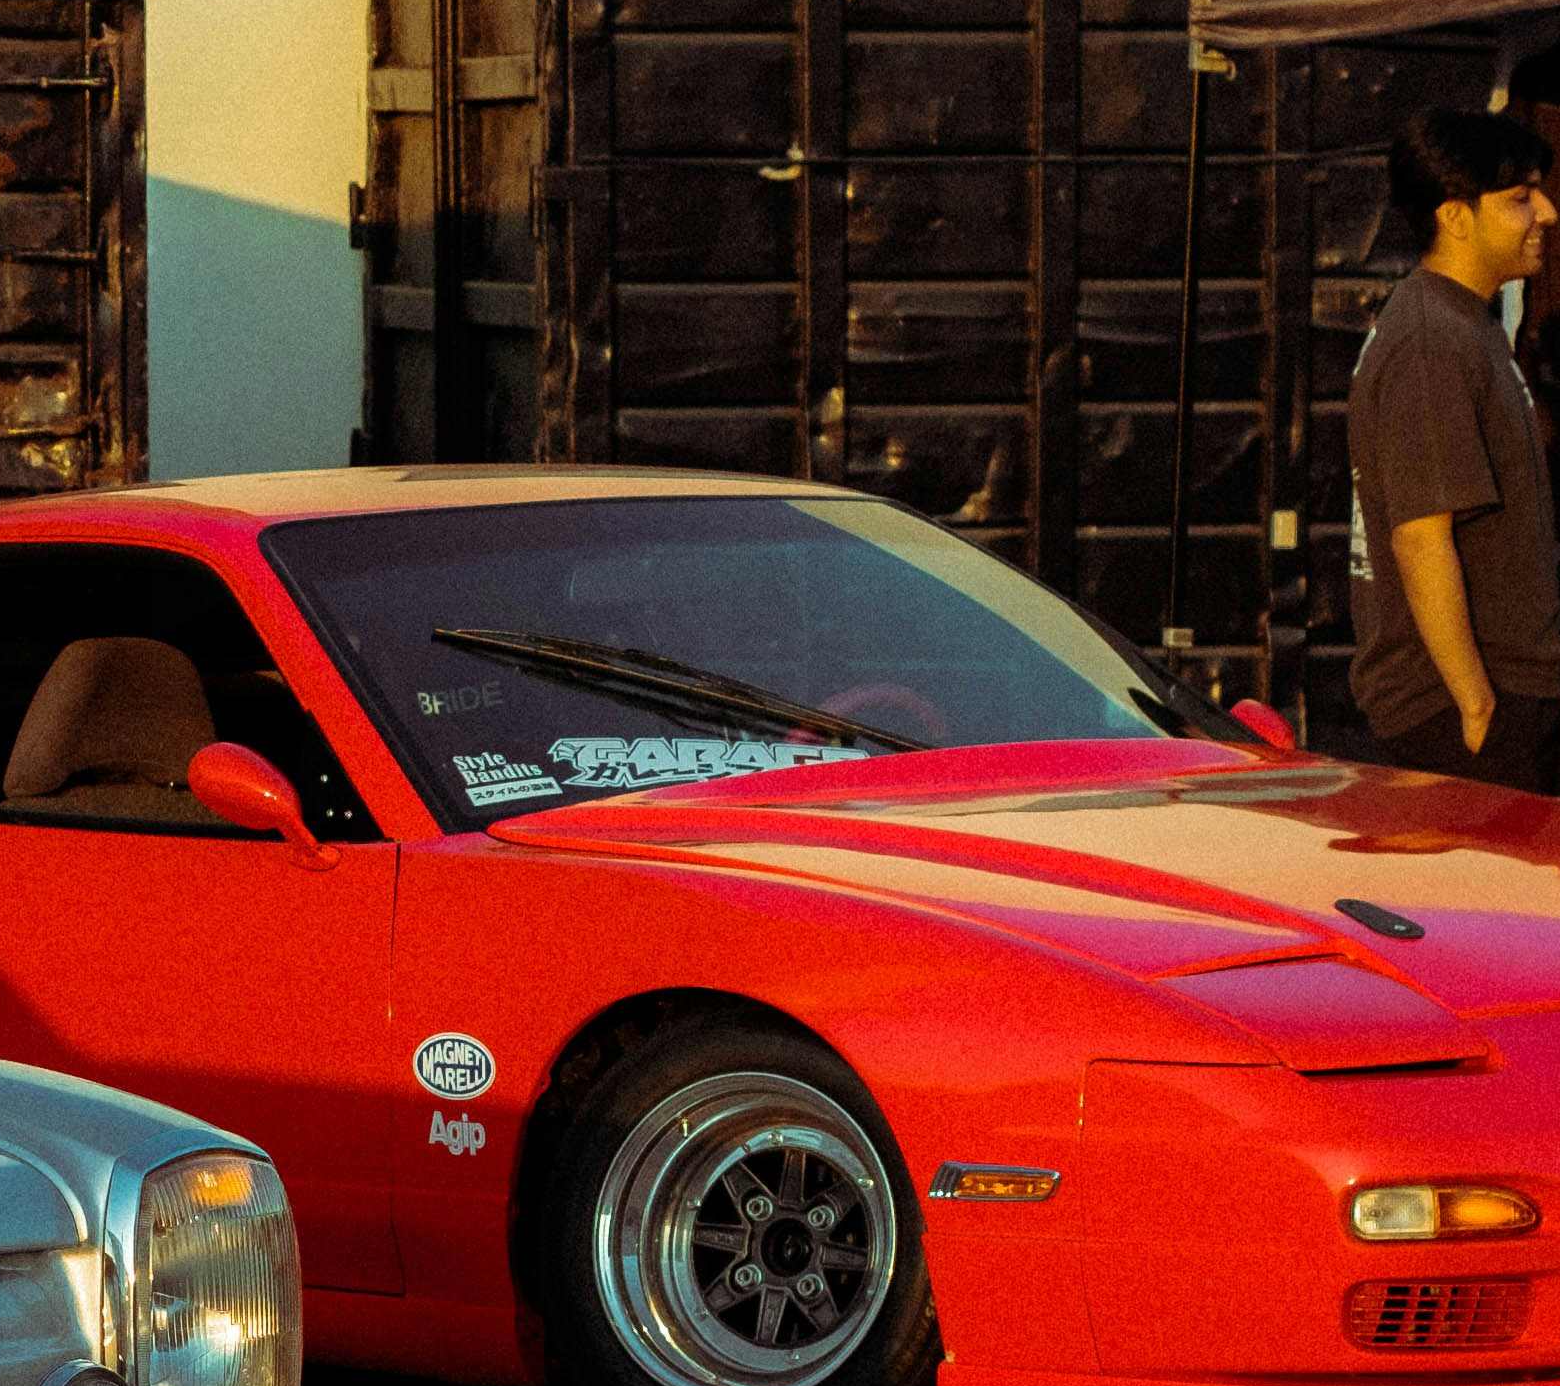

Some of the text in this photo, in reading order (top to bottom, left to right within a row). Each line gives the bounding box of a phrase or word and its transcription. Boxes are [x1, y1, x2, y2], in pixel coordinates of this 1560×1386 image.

[417, 680, 505, 715] BRIDE
[453, 751, 507, 772] Style
[459, 762, 543, 786] Bandits
[422, 1040, 487, 1073] MAGNETI
[422, 1057, 487, 1091] MARELLI
[428, 1110, 486, 1156] Agip
